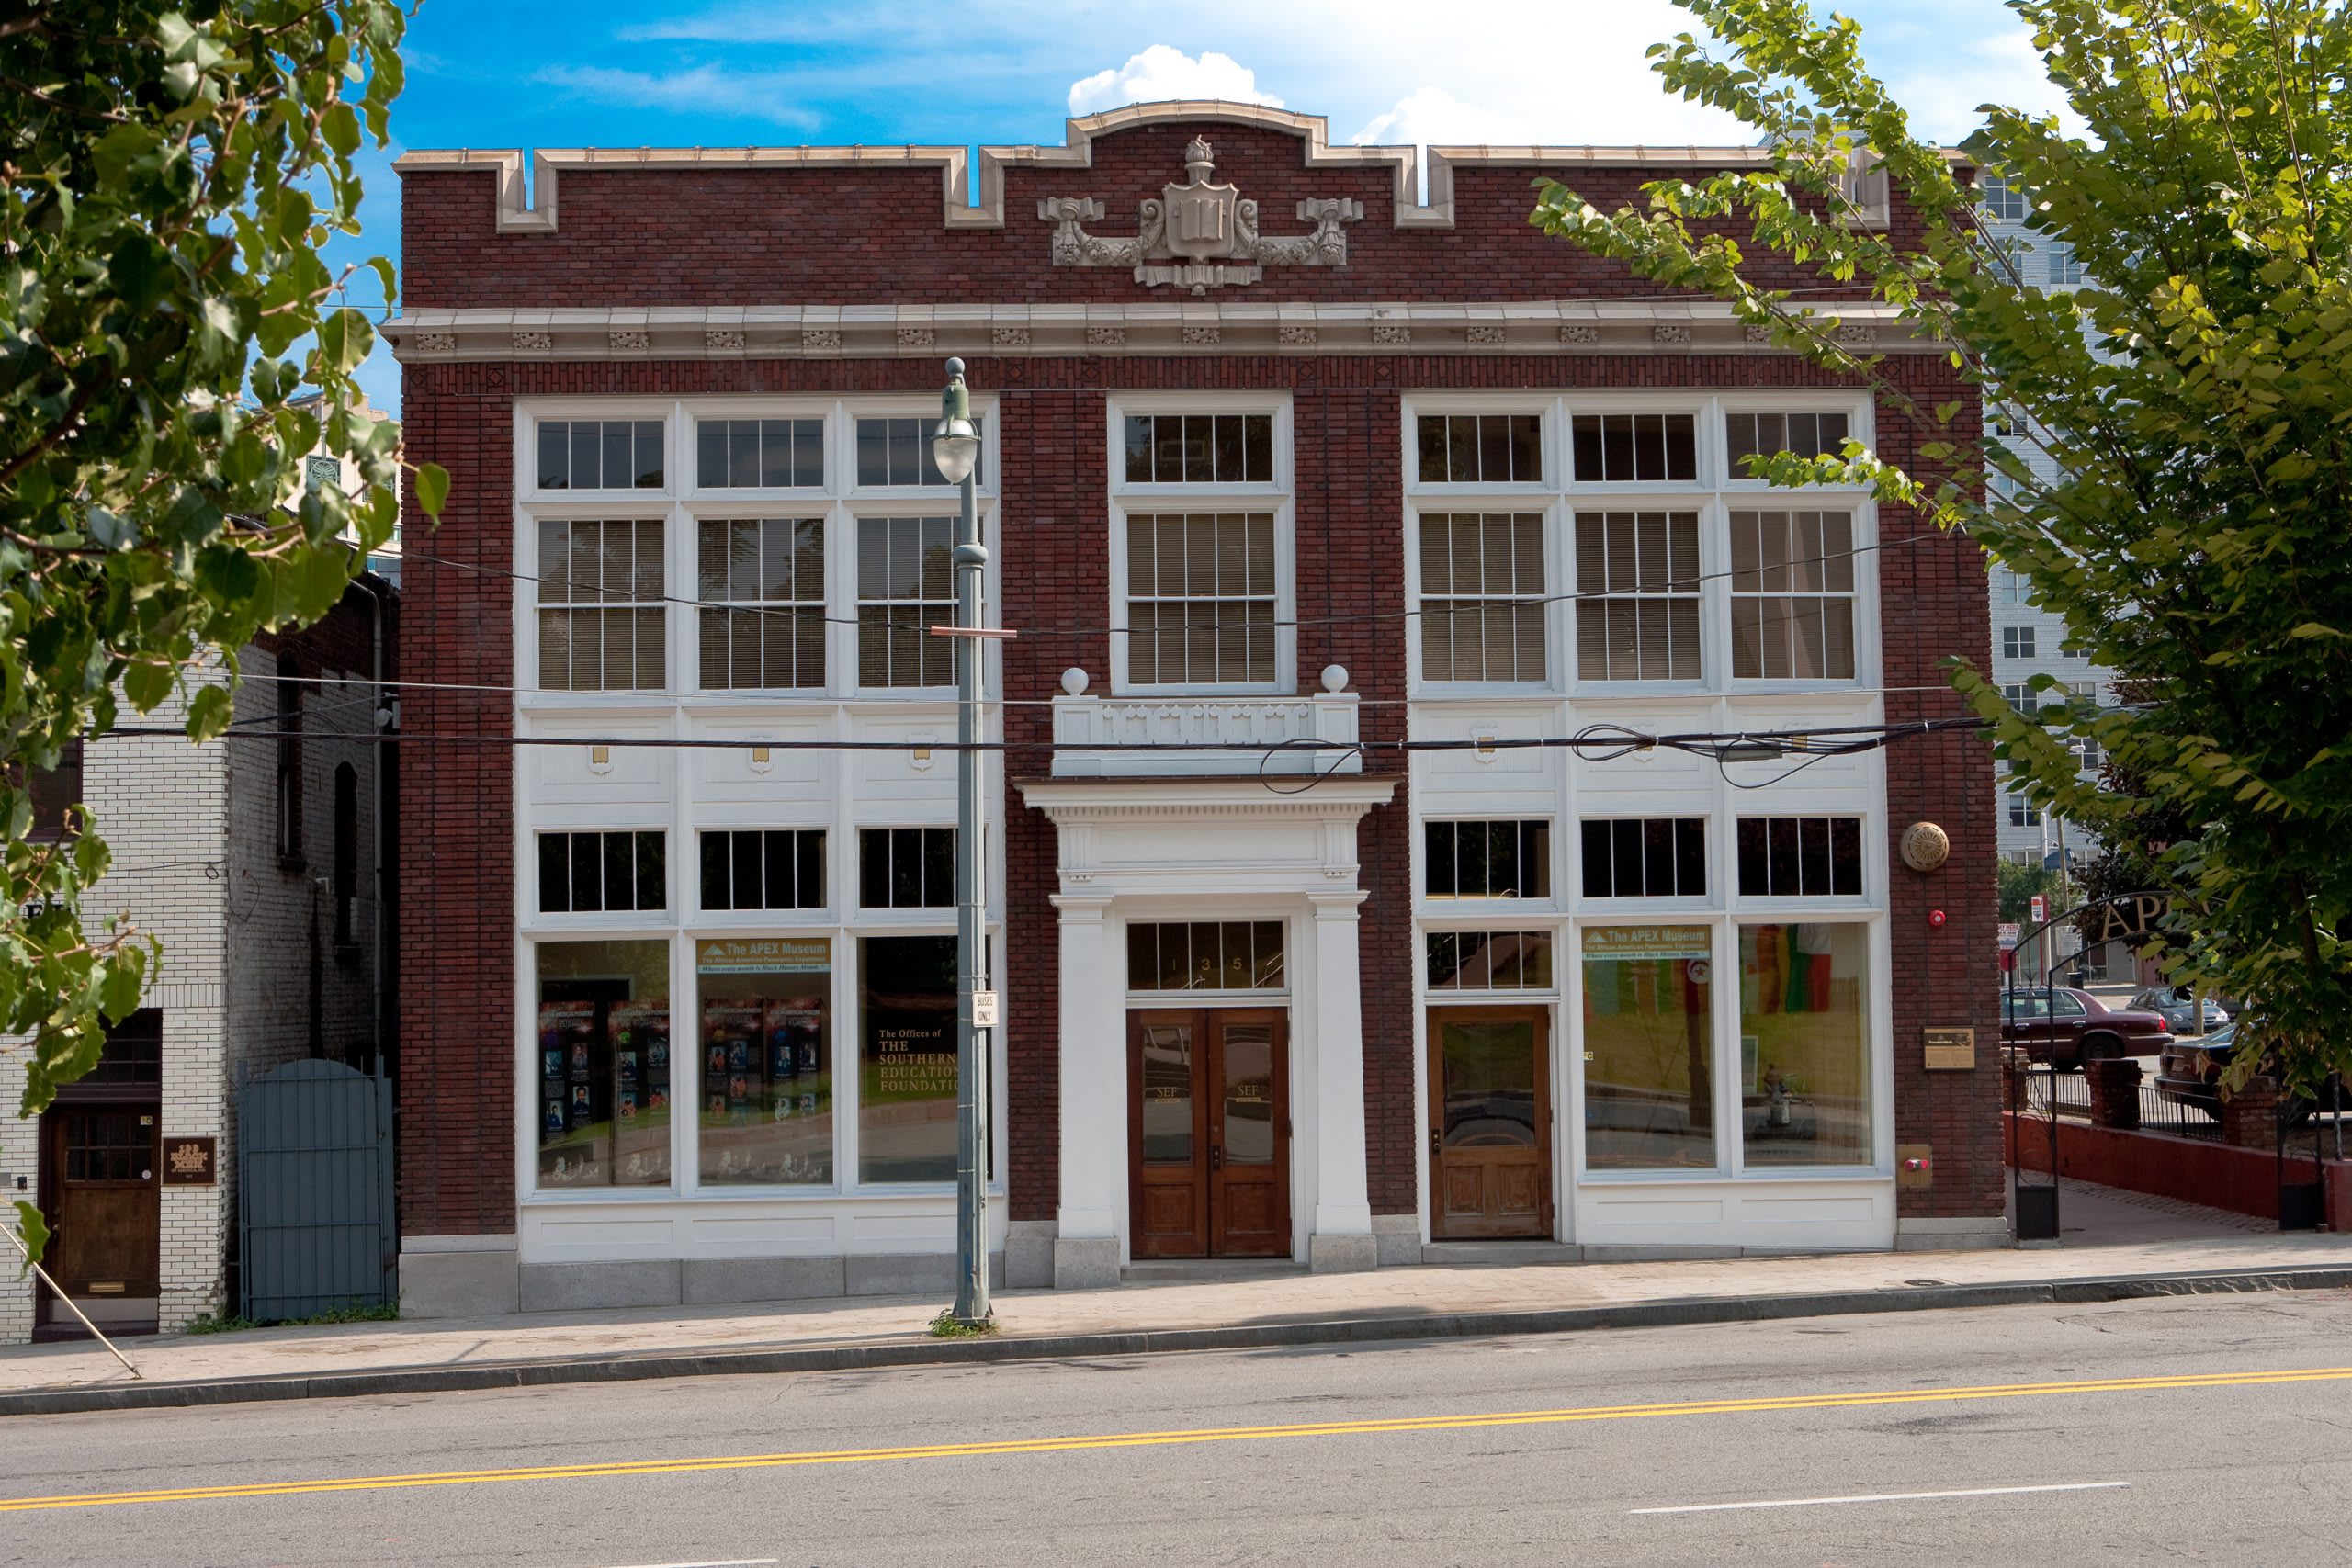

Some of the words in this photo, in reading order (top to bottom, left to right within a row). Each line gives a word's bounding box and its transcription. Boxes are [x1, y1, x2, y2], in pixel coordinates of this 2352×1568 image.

[2098, 895, 2214, 941] AP
[1607, 931, 1627, 942] The
[1631, 930, 1658, 942] APEX
[1662, 930, 1705, 942] Museum
[726, 942, 747, 954] The
[750, 942, 779, 954] APEX
[782, 942, 826, 954] Museum
[977, 996, 993, 1006] BUSES
[978, 1011, 991, 1021] ONLY
[879, 1030, 896, 1038] The
[899, 1029, 929, 1038] Offices
[933, 1029, 942, 1038] of
[879, 1041, 909, 1052] THE
[879, 1053, 956, 1065] SOUTHERN
[880, 1079, 958, 1091] FOUNDATI
[1238, 1085, 1258, 1096] SEF
[1158, 1087, 1177, 1098] SEF
